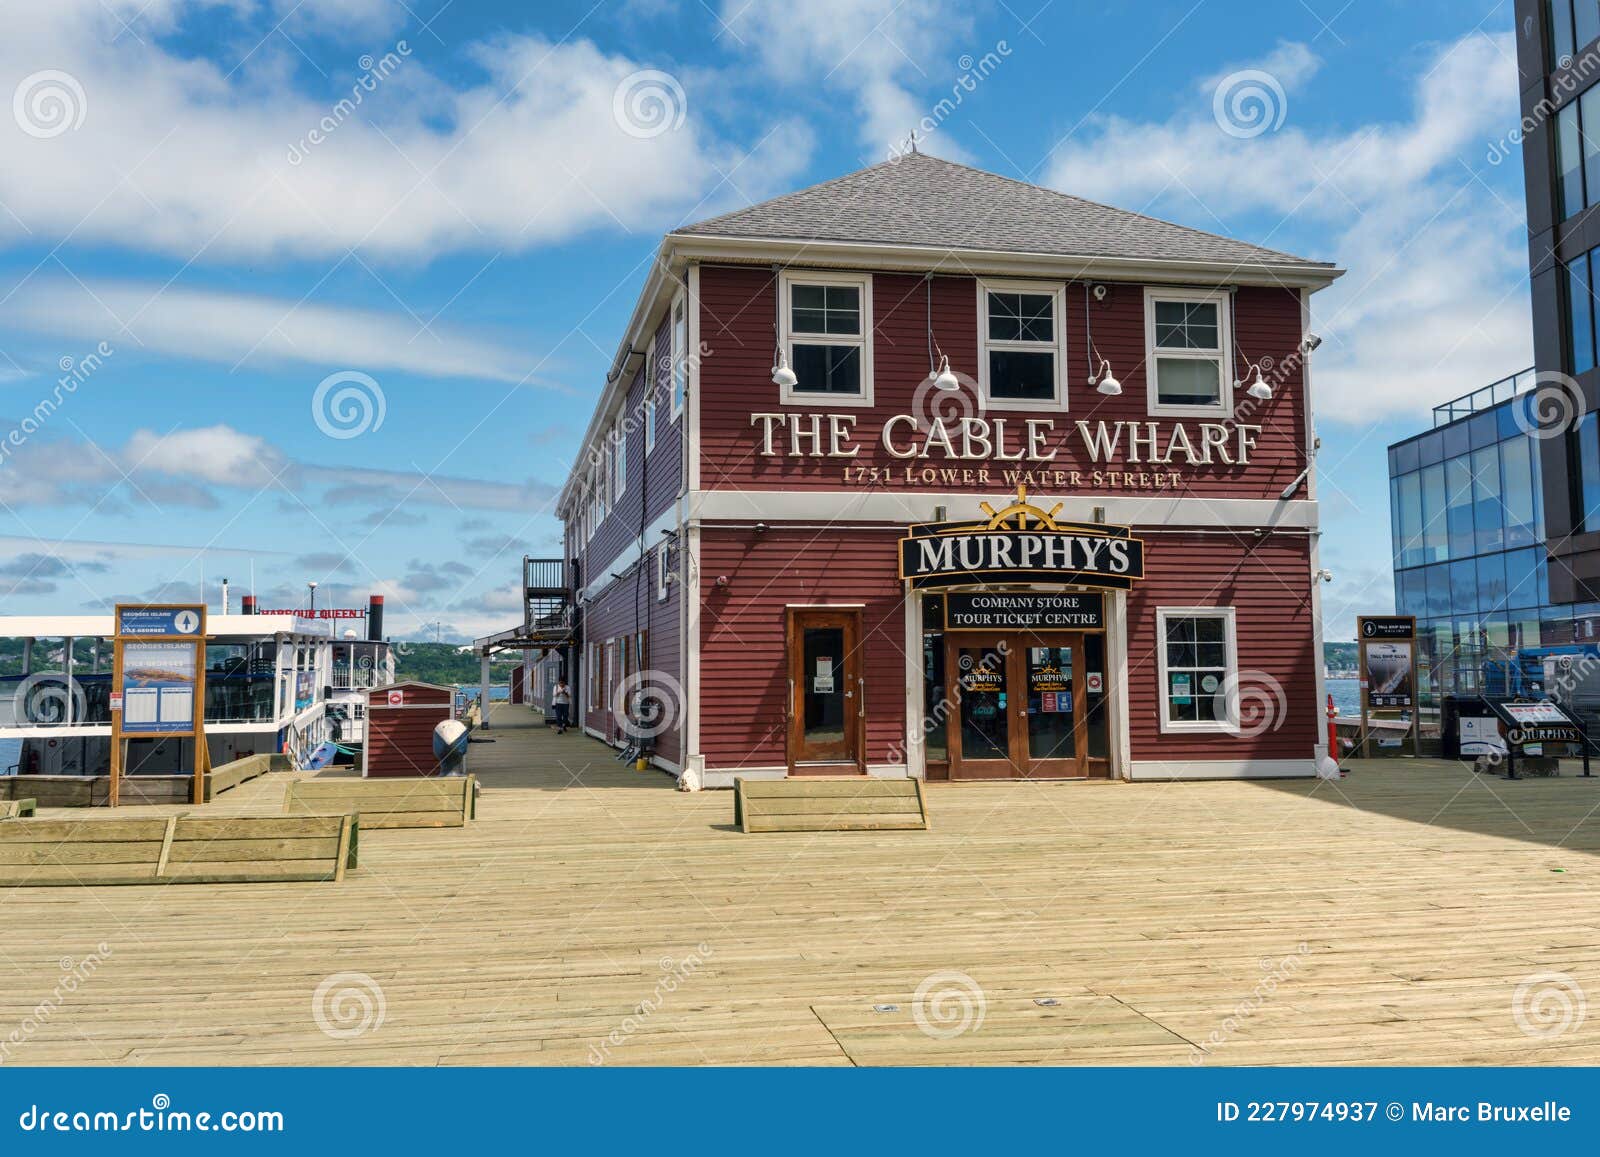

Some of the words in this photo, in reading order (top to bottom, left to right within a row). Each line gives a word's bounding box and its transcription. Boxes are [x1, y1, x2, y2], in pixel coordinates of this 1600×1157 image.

[750, 412, 861, 458] THE
[882, 414, 1059, 461] CABLE
[1075, 420, 1263, 466] WHARF
[841, 466, 893, 483] 1751
[905, 467, 991, 484] LOWER
[1003, 469, 1082, 487] WATER
[1093, 471, 1182, 488] STREET
[916, 535, 1130, 573] MURPHY'S
[971, 597, 1034, 609] COMPANY
[1037, 597, 1080, 609] STORE
[320, 609, 356, 619] QUEEN
[954, 613, 991, 624] TOUR
[993, 613, 1043, 625] TICKET
[1045, 613, 1097, 625] CENTRE
